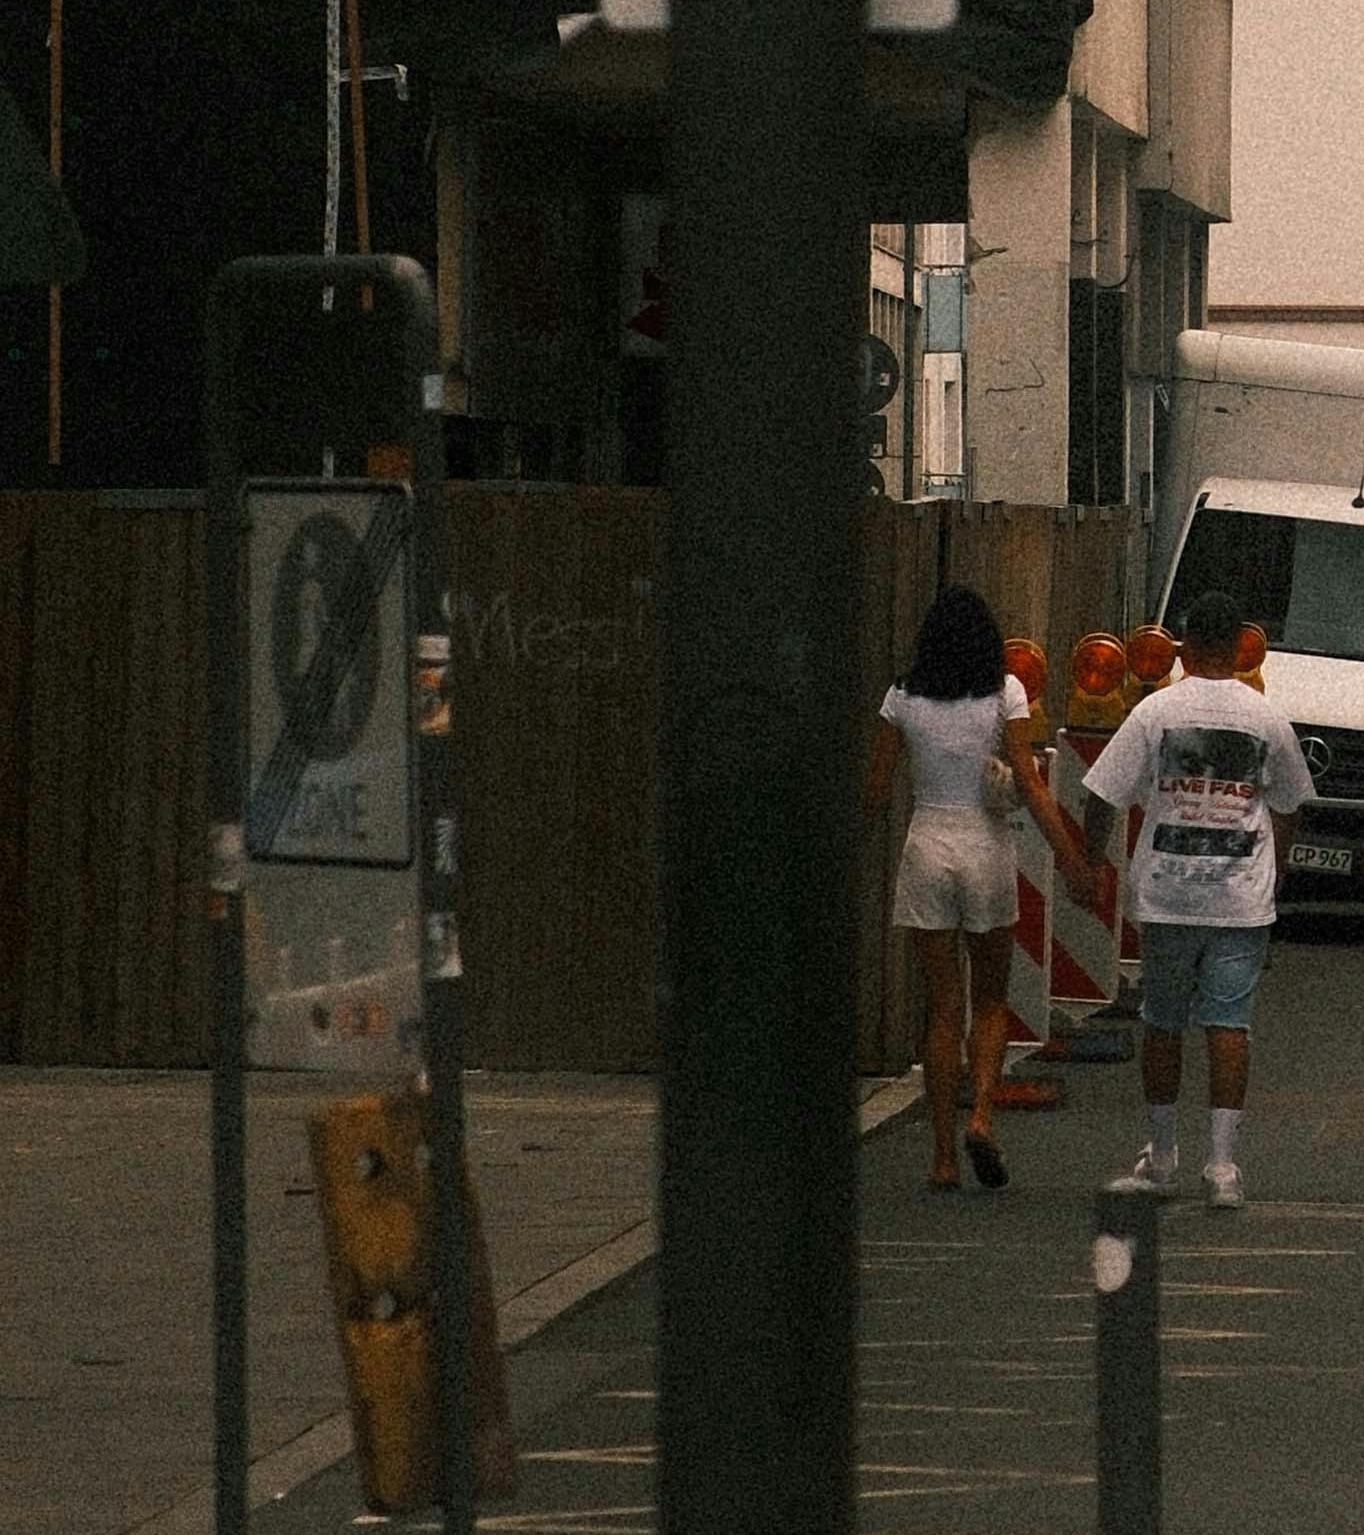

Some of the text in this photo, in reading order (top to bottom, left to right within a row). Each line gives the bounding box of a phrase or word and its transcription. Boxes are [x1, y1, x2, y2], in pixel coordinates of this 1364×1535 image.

[1158, 779, 1258, 800] LIVE FAS
[1319, 850, 1350, 869] 967
